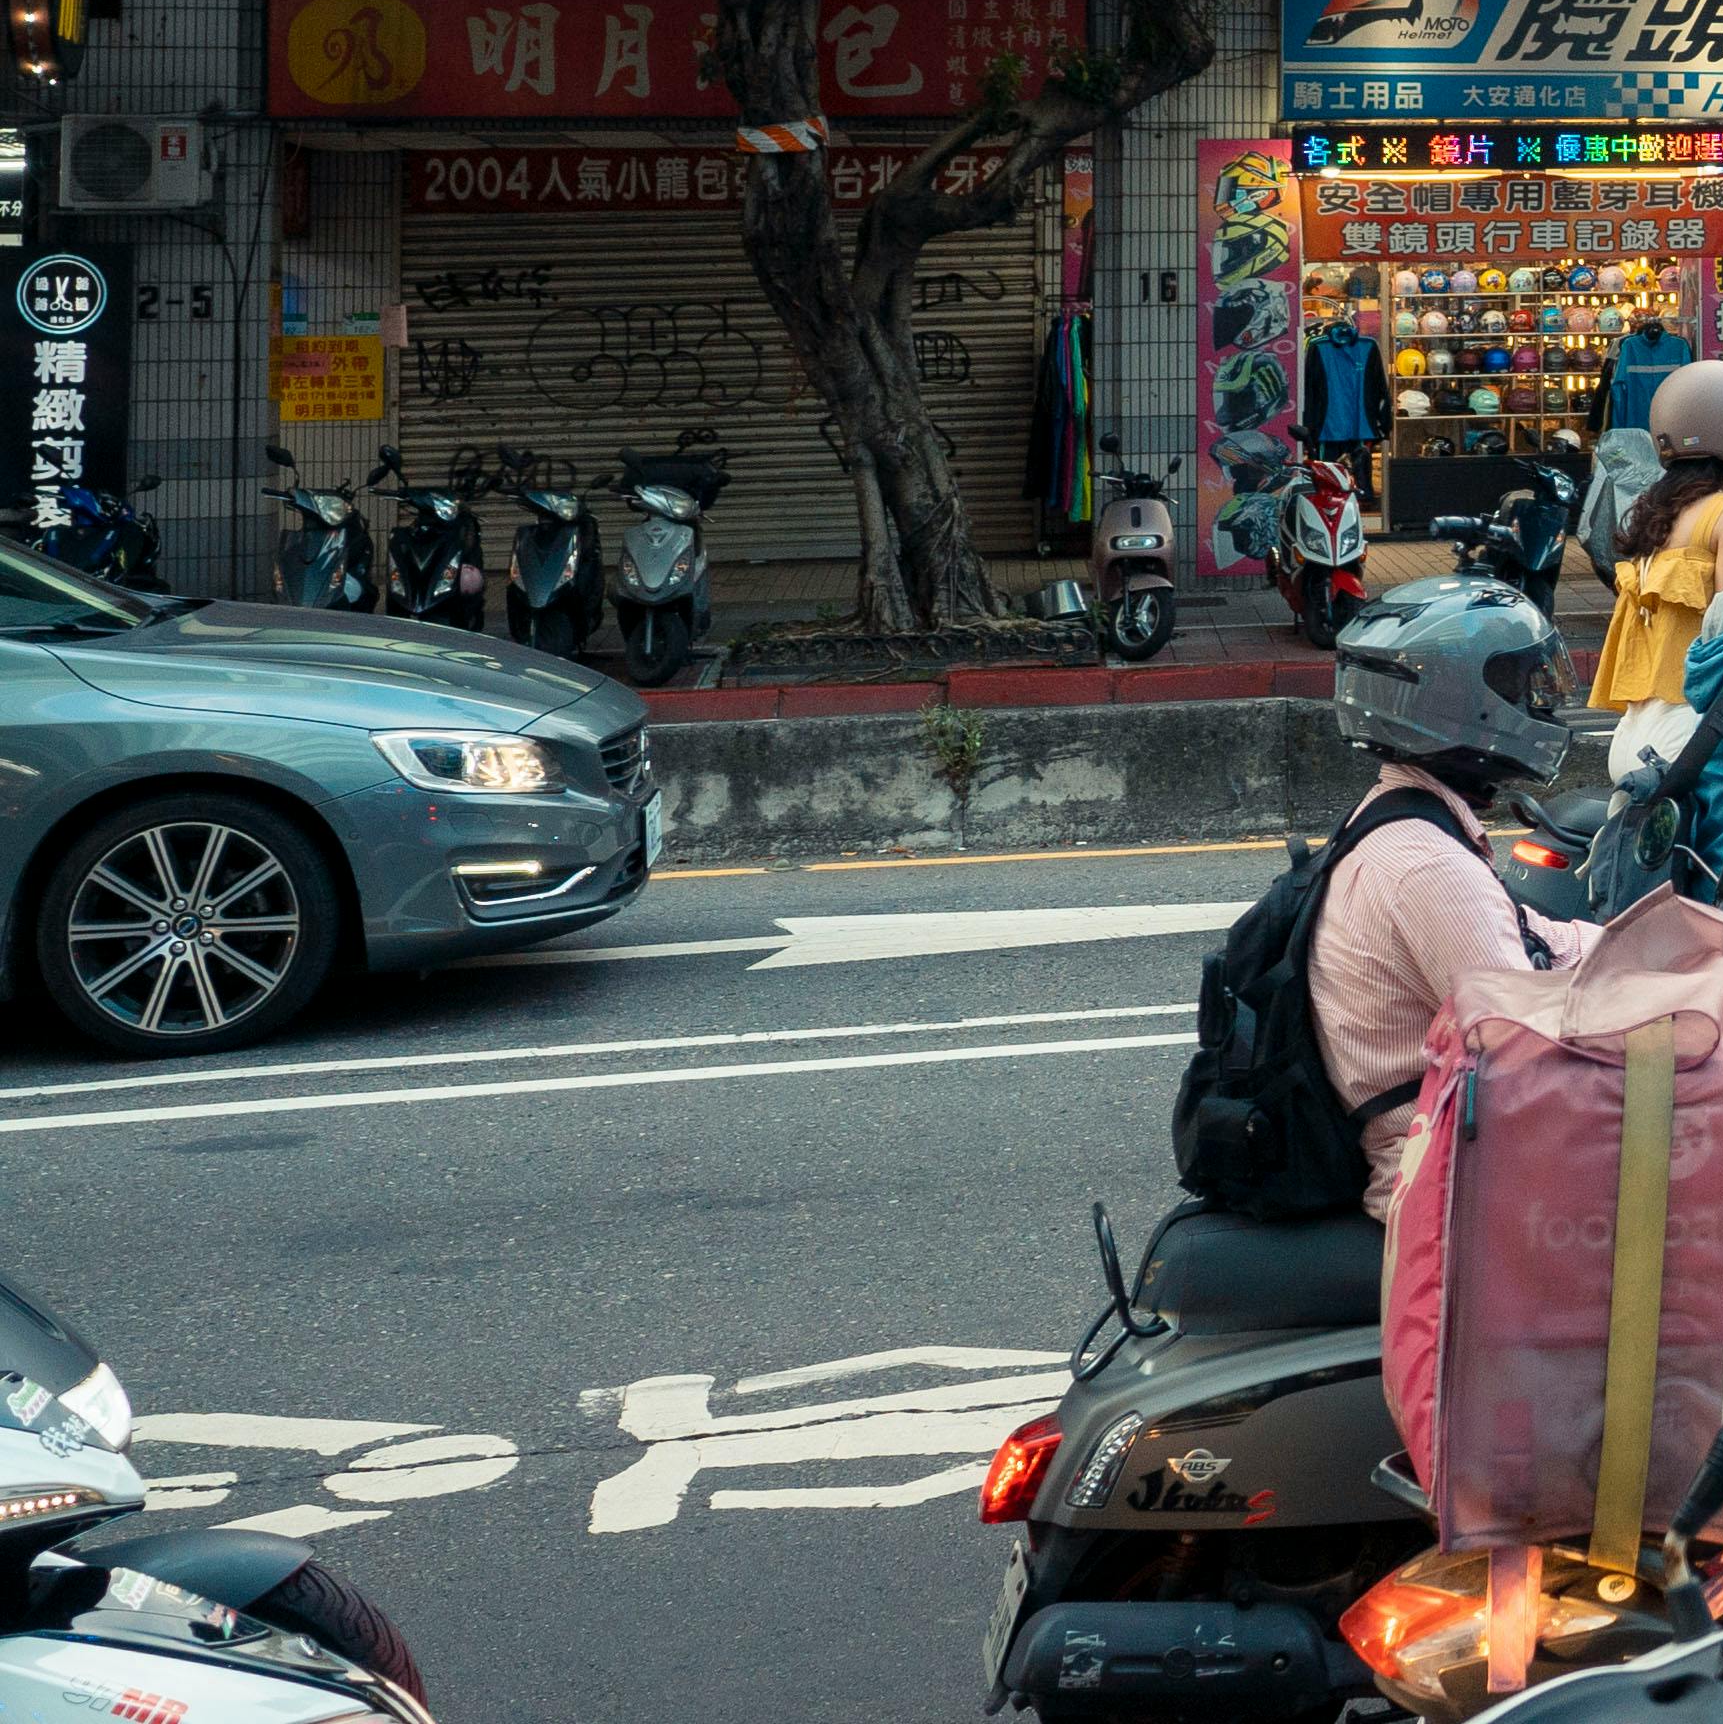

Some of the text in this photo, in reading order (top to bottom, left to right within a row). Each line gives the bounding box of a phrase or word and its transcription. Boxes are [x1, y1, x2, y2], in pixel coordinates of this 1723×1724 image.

[1397, 28, 1454, 41] Helmet
[465, 2, 924, 99] 明月包
[1293, 81, 1587, 110] 騎士用品 大安通化店
[1303, 135, 1367, 166] 各式
[1428, 134, 1495, 166] 鏡片
[1340, 218, 1706, 257] 雙鏡頭行車記錄器
[137, 285, 213, 320] 2-5
[1138, 272, 1177, 303] 16
[294, 403, 360, 418] 明月湯包
[1180, 1460, 1218, 1473] ABS
